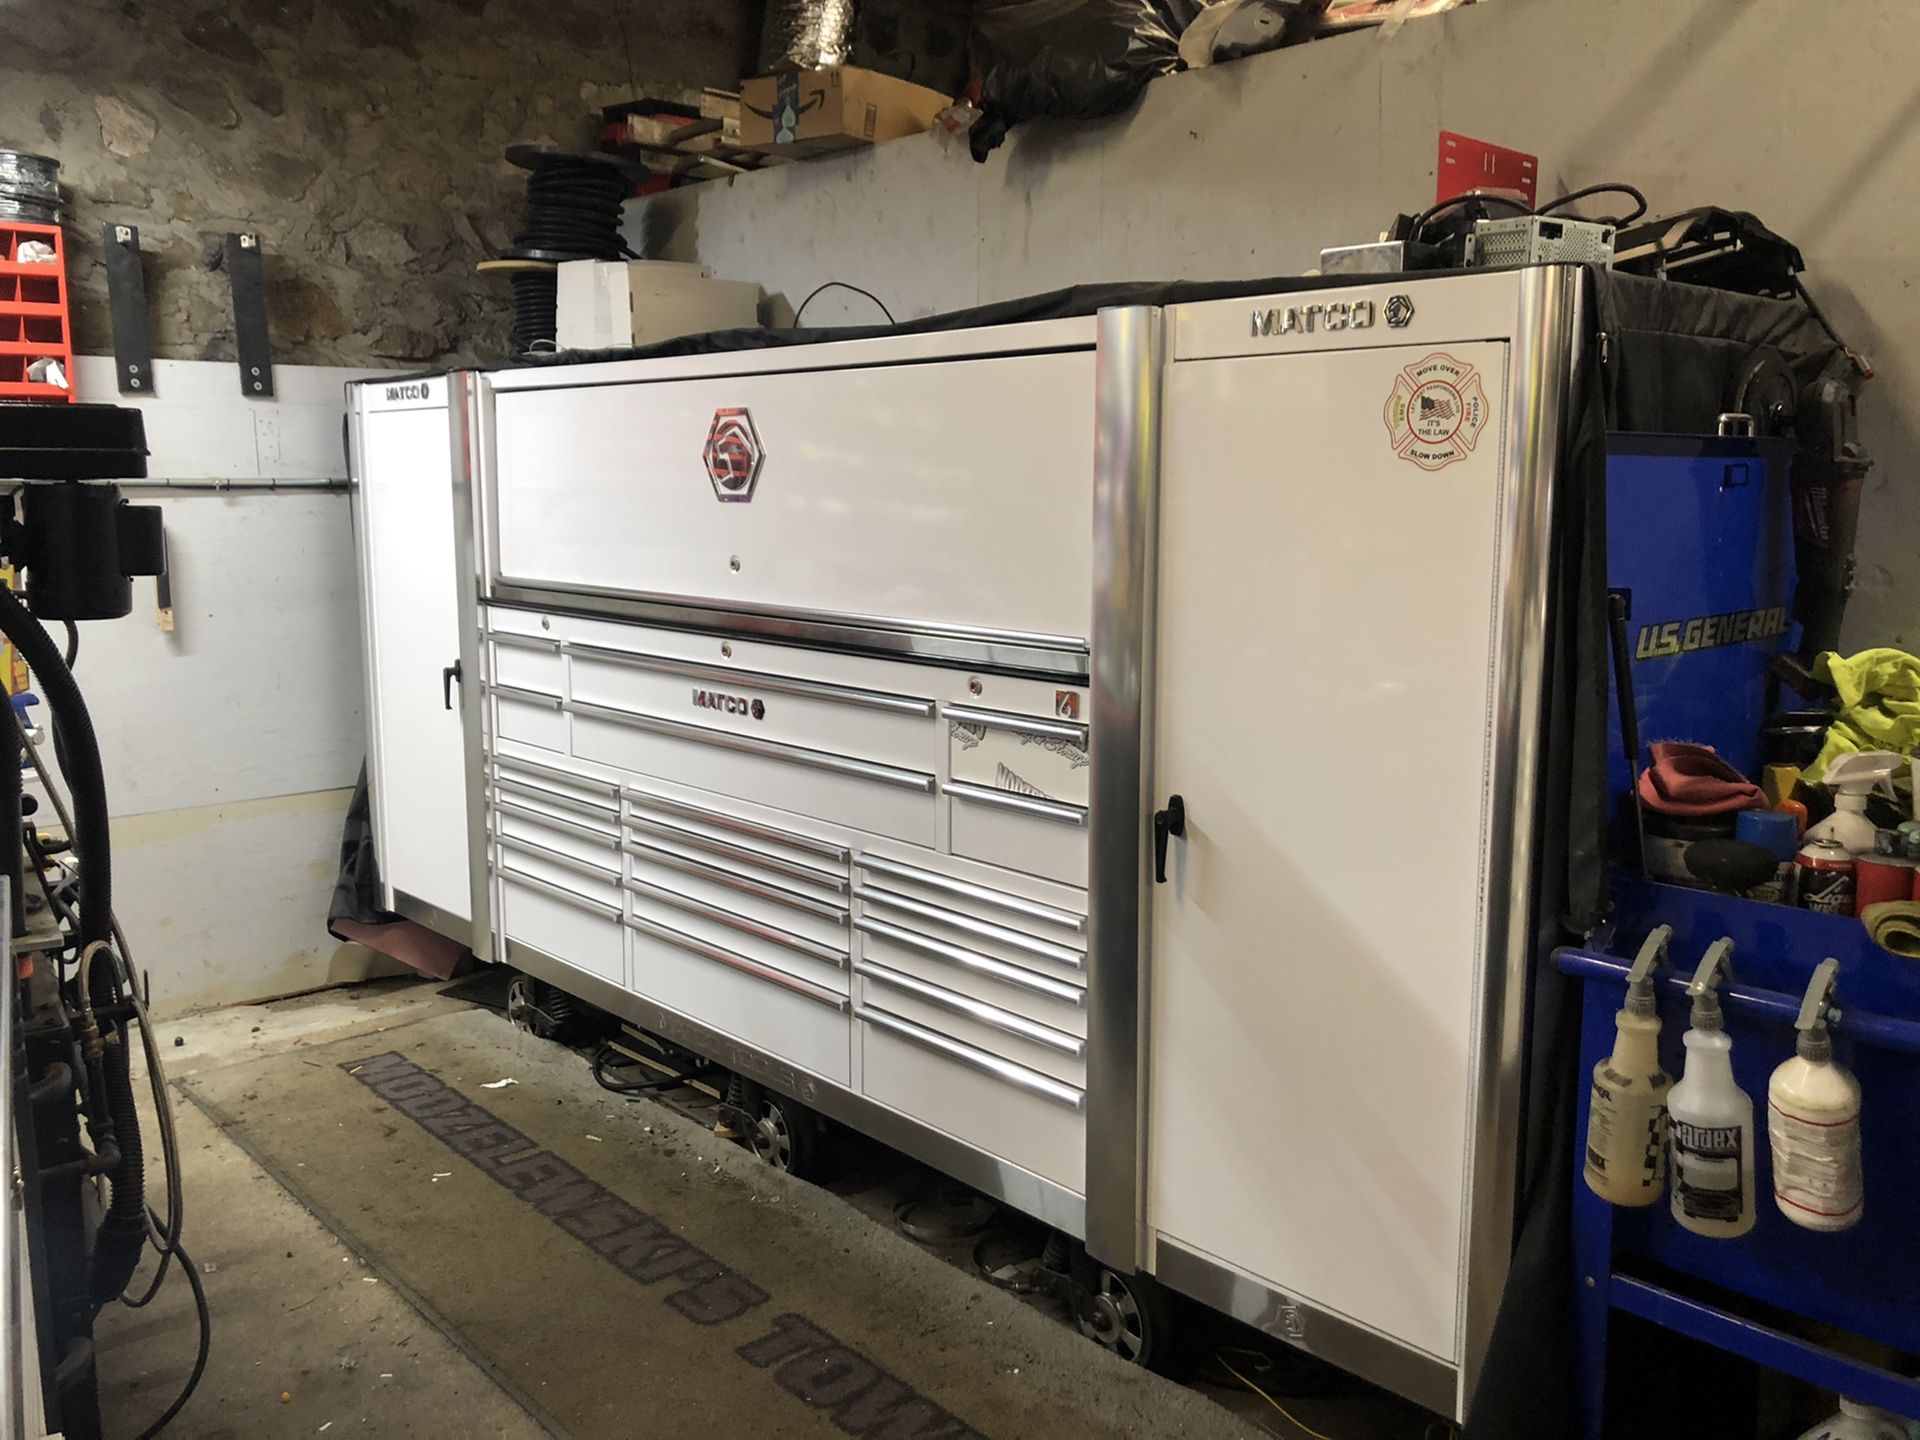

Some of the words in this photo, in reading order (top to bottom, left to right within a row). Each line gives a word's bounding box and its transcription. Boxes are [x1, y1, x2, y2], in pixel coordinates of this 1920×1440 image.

[1250, 300, 1376, 337] MATCO
[1416, 364, 1438, 377] MOVE
[1440, 364, 1461, 377] OVER
[386, 384, 420, 401] MATCO
[1427, 420, 1441, 428] IT'S
[1470, 396, 1479, 429] POLICE
[1433, 428, 1450, 436] LAW
[1410, 449, 1431, 460] SLOW
[1432, 450, 1455, 460] DOWN
[1683, 606, 1791, 651] GENERAL
[692, 688, 749, 717] MATCO
[336, 1050, 772, 1327] MODZELEWSKI'S
